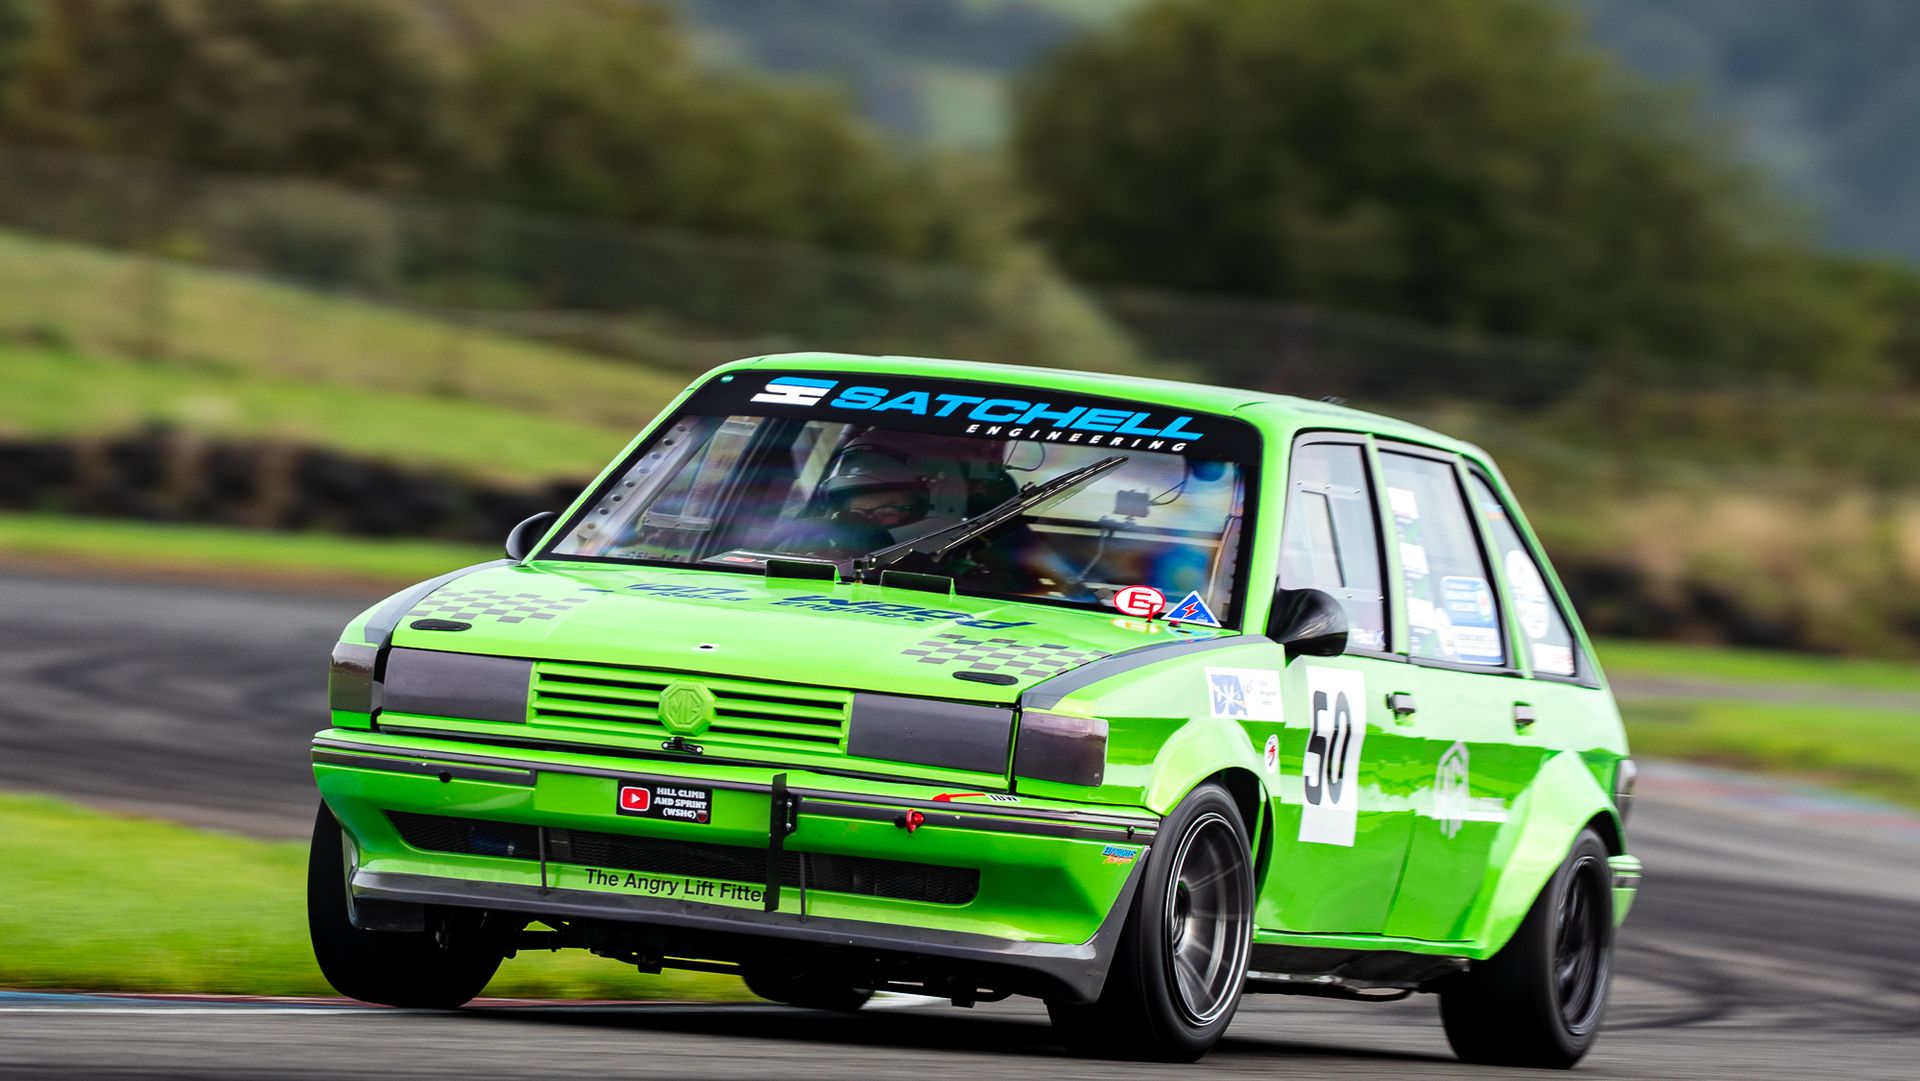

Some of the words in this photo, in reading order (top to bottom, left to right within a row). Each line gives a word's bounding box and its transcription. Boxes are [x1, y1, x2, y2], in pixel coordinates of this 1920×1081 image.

[830, 386, 1204, 441] SATCHELL
[965, 423, 1188, 452] ENGINEERING
[1304, 690, 1352, 806] 50
[654, 797, 675, 806] AND
[675, 799, 707, 809] SPRINT
[656, 787, 677, 797] HILL
[678, 790, 706, 799] CLIMB
[662, 807, 697, 819] (WSHC)
[586, 869, 619, 886] The
[624, 873, 680, 896] Angry
[684, 879, 715, 897] Lift
